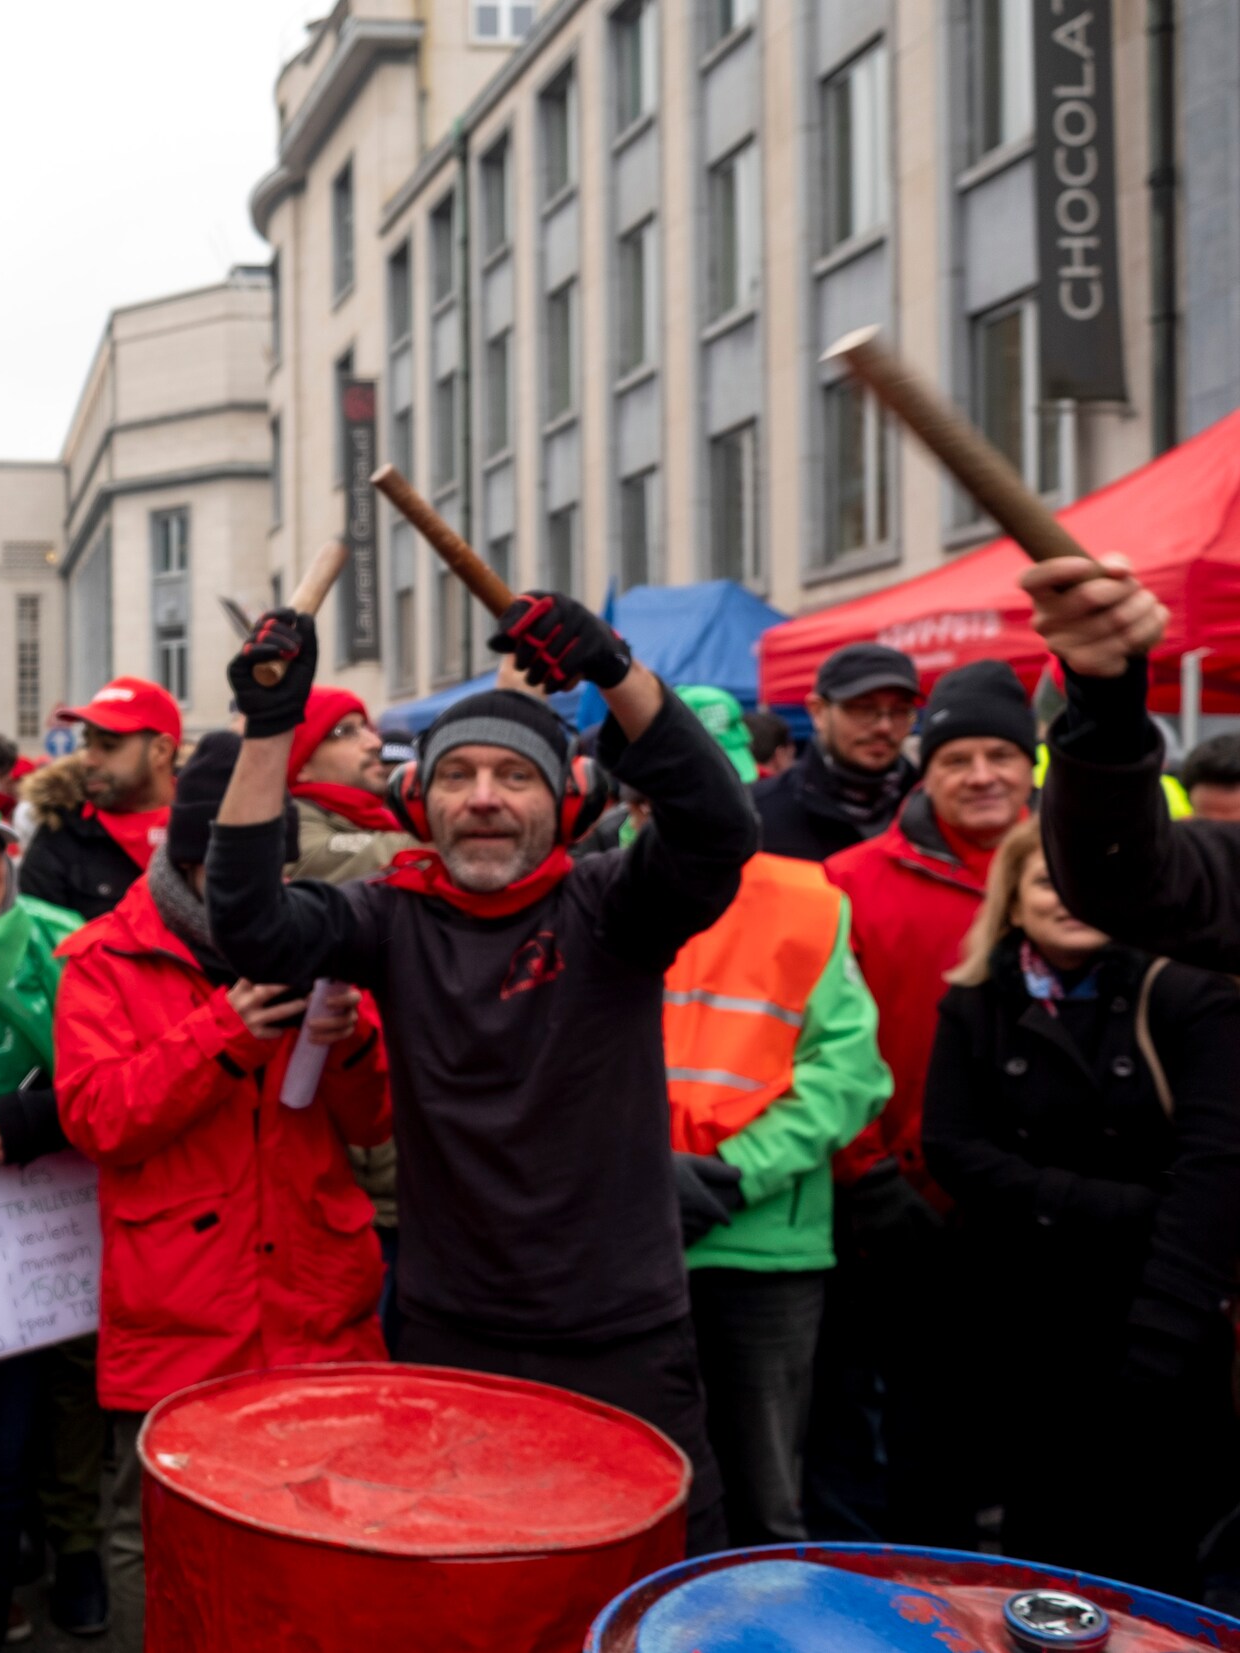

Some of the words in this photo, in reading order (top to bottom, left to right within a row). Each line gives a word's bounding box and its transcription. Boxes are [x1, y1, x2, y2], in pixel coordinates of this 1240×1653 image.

[1051, 0, 1105, 321] CHOCOLA
[354, 547, 373, 649] Laurent
[17, 1218, 82, 1247] veulent
[21, 1244, 93, 1274] minimum
